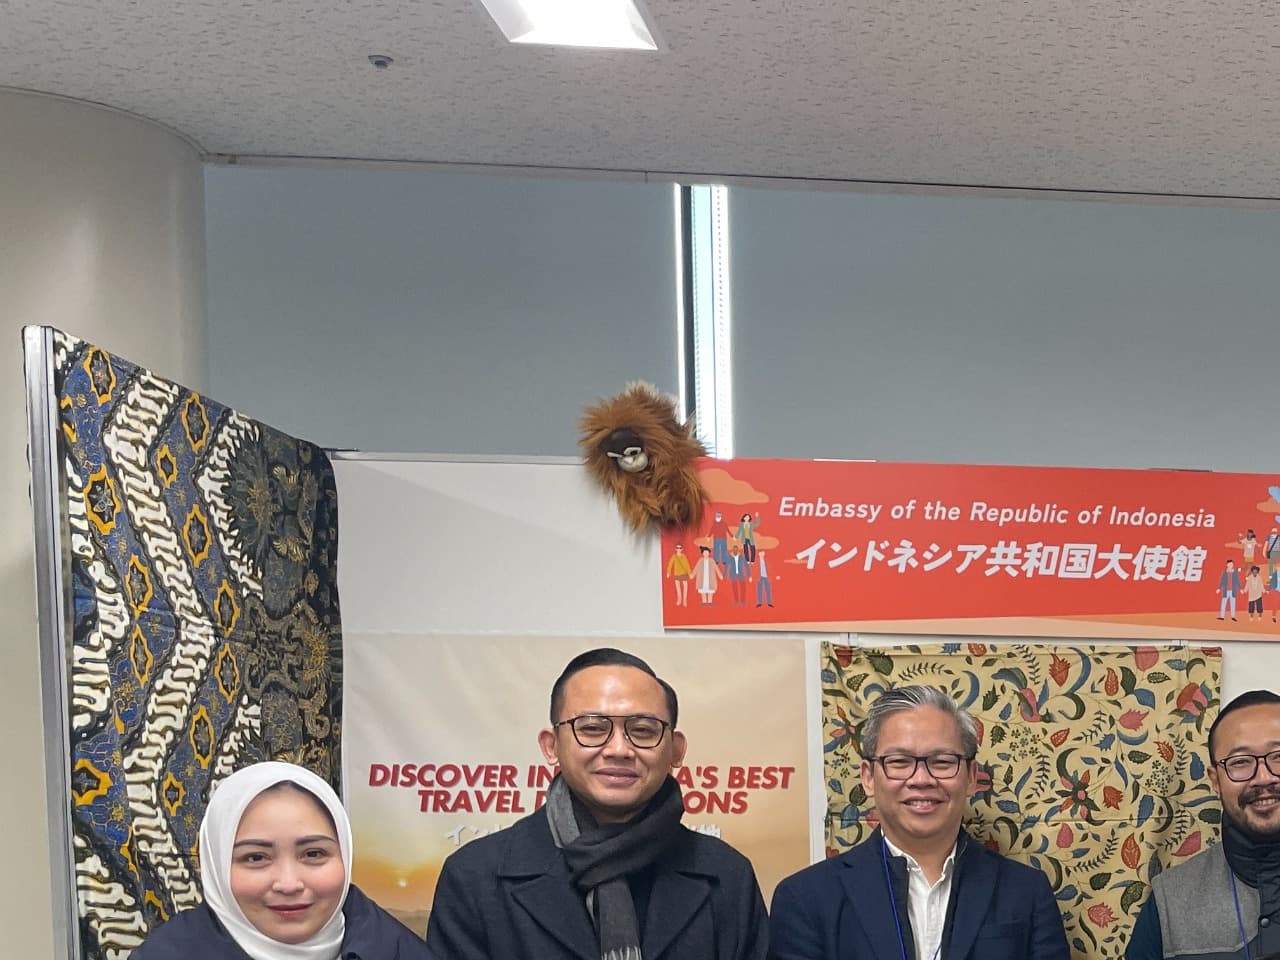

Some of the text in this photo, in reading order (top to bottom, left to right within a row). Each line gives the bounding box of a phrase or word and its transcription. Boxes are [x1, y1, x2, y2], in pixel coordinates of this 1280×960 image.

[779, 496, 1215, 528] Embassy of the Republic of Indonesia
[796, 538, 1208, 582] インドネシア共和国大使館
[368, 763, 518, 788] DISCOVER
[727, 766, 795, 789] BEST
[418, 790, 525, 813] TRAVEL
